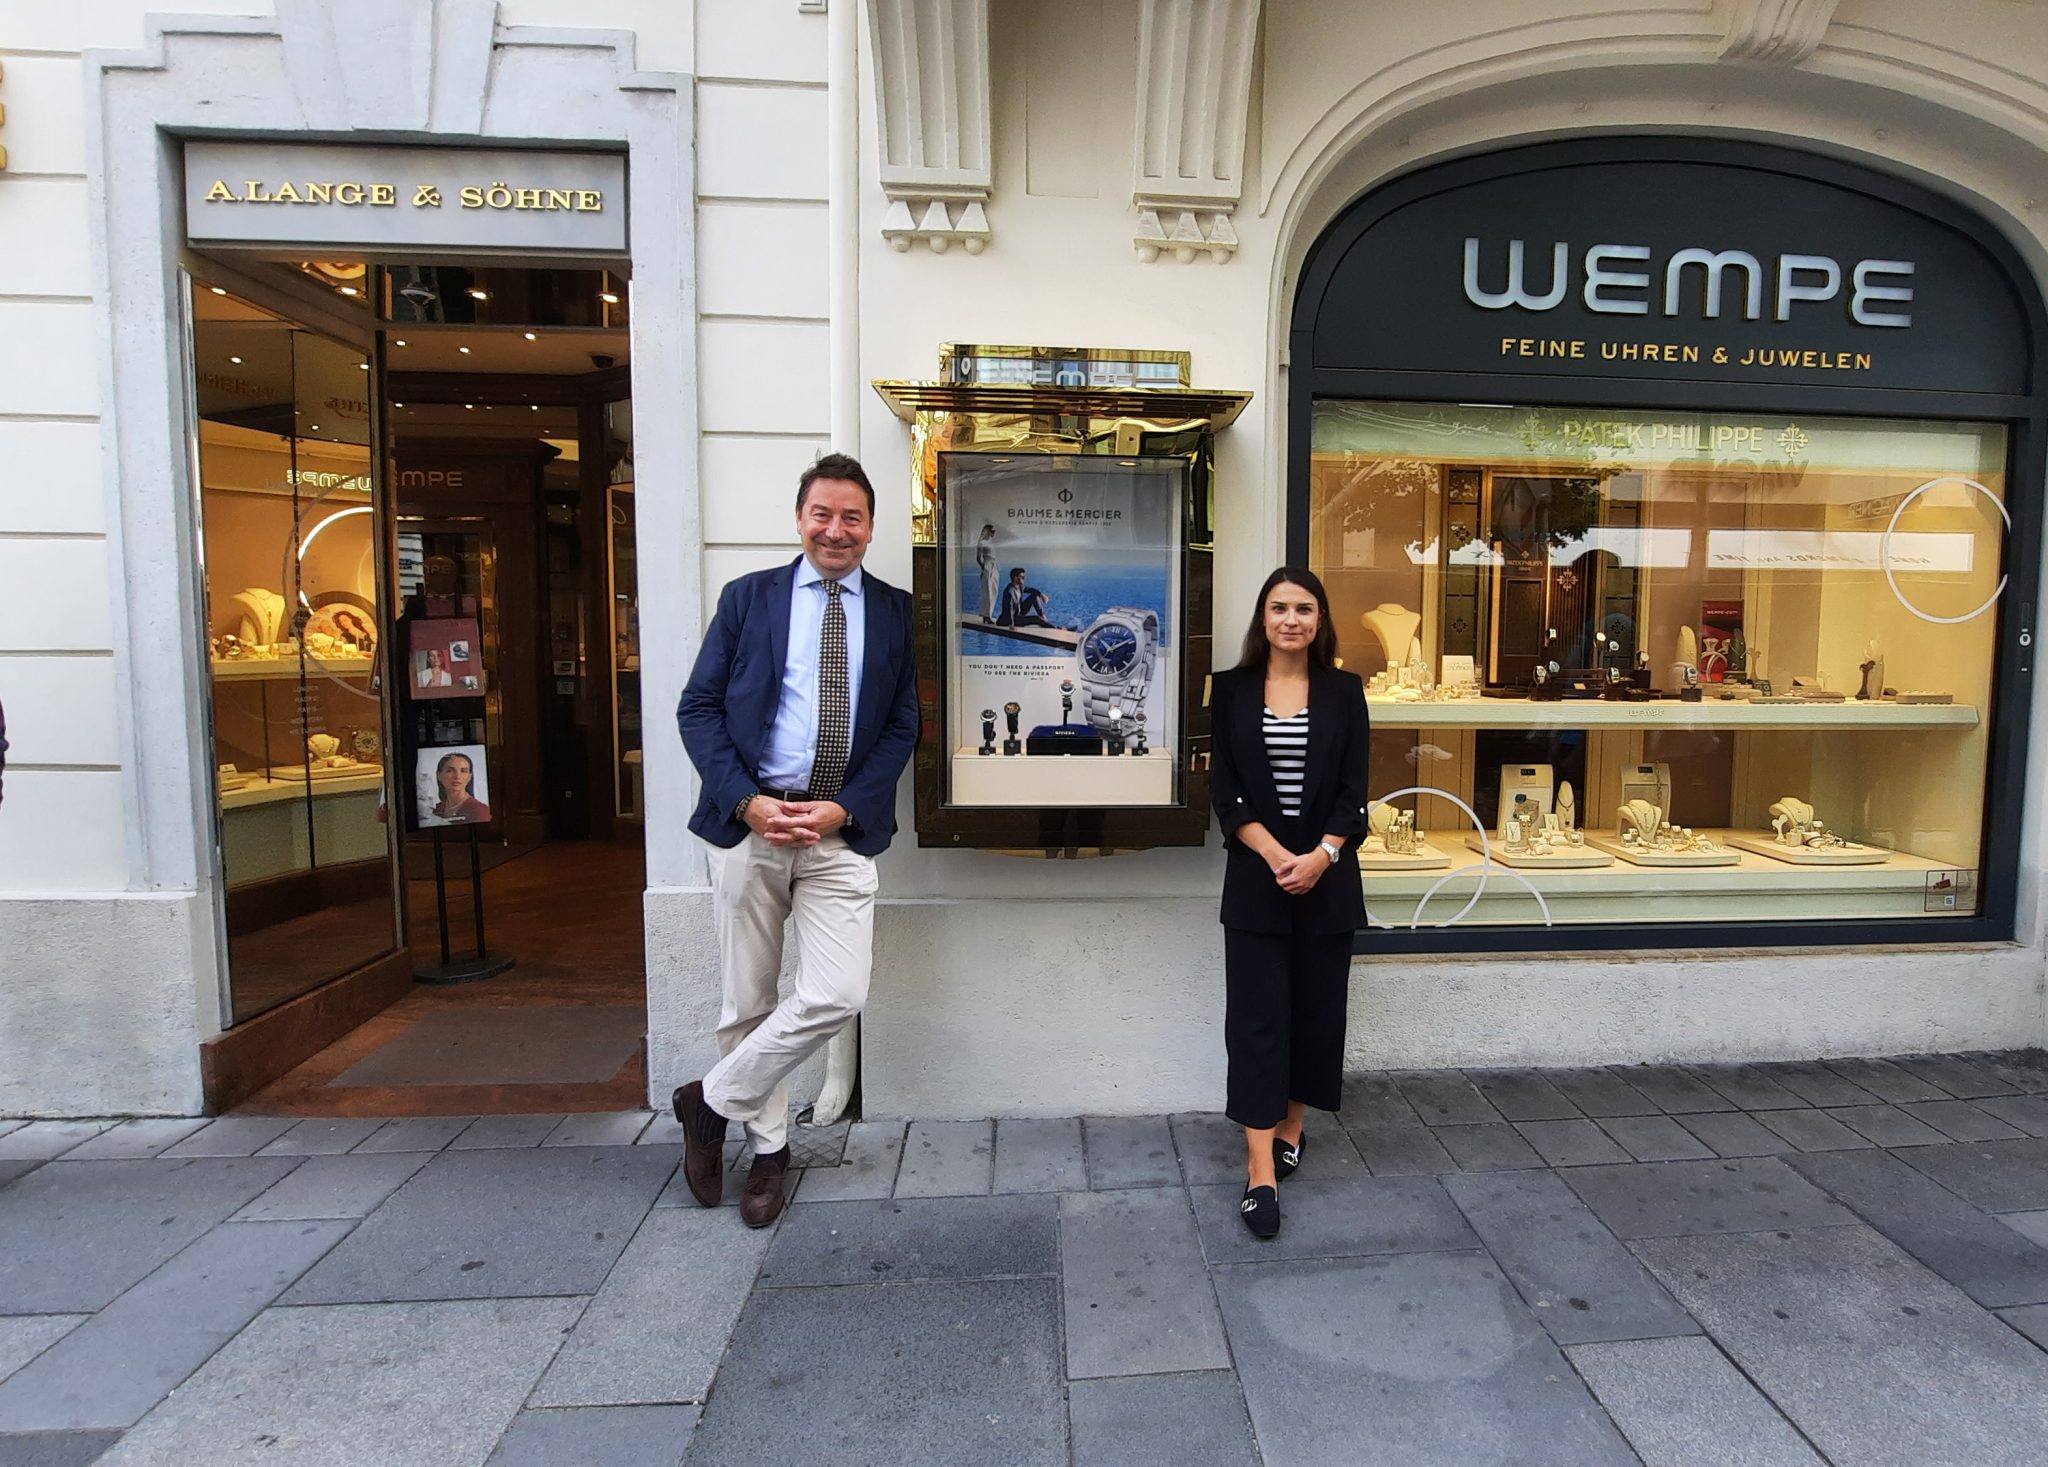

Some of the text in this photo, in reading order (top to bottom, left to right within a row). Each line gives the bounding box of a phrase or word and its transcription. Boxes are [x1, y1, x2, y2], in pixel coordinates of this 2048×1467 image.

[205, 180, 602, 212] A.LANGE & SÖHNE
[1463, 237, 1916, 327] WEMPE
[1501, 338, 1872, 370] FEINE UHREN & JUWELEN
[1563, 419, 1764, 451] PATEK PHILIPPE
[1007, 508, 1121, 520] BAUME & MERCIER
